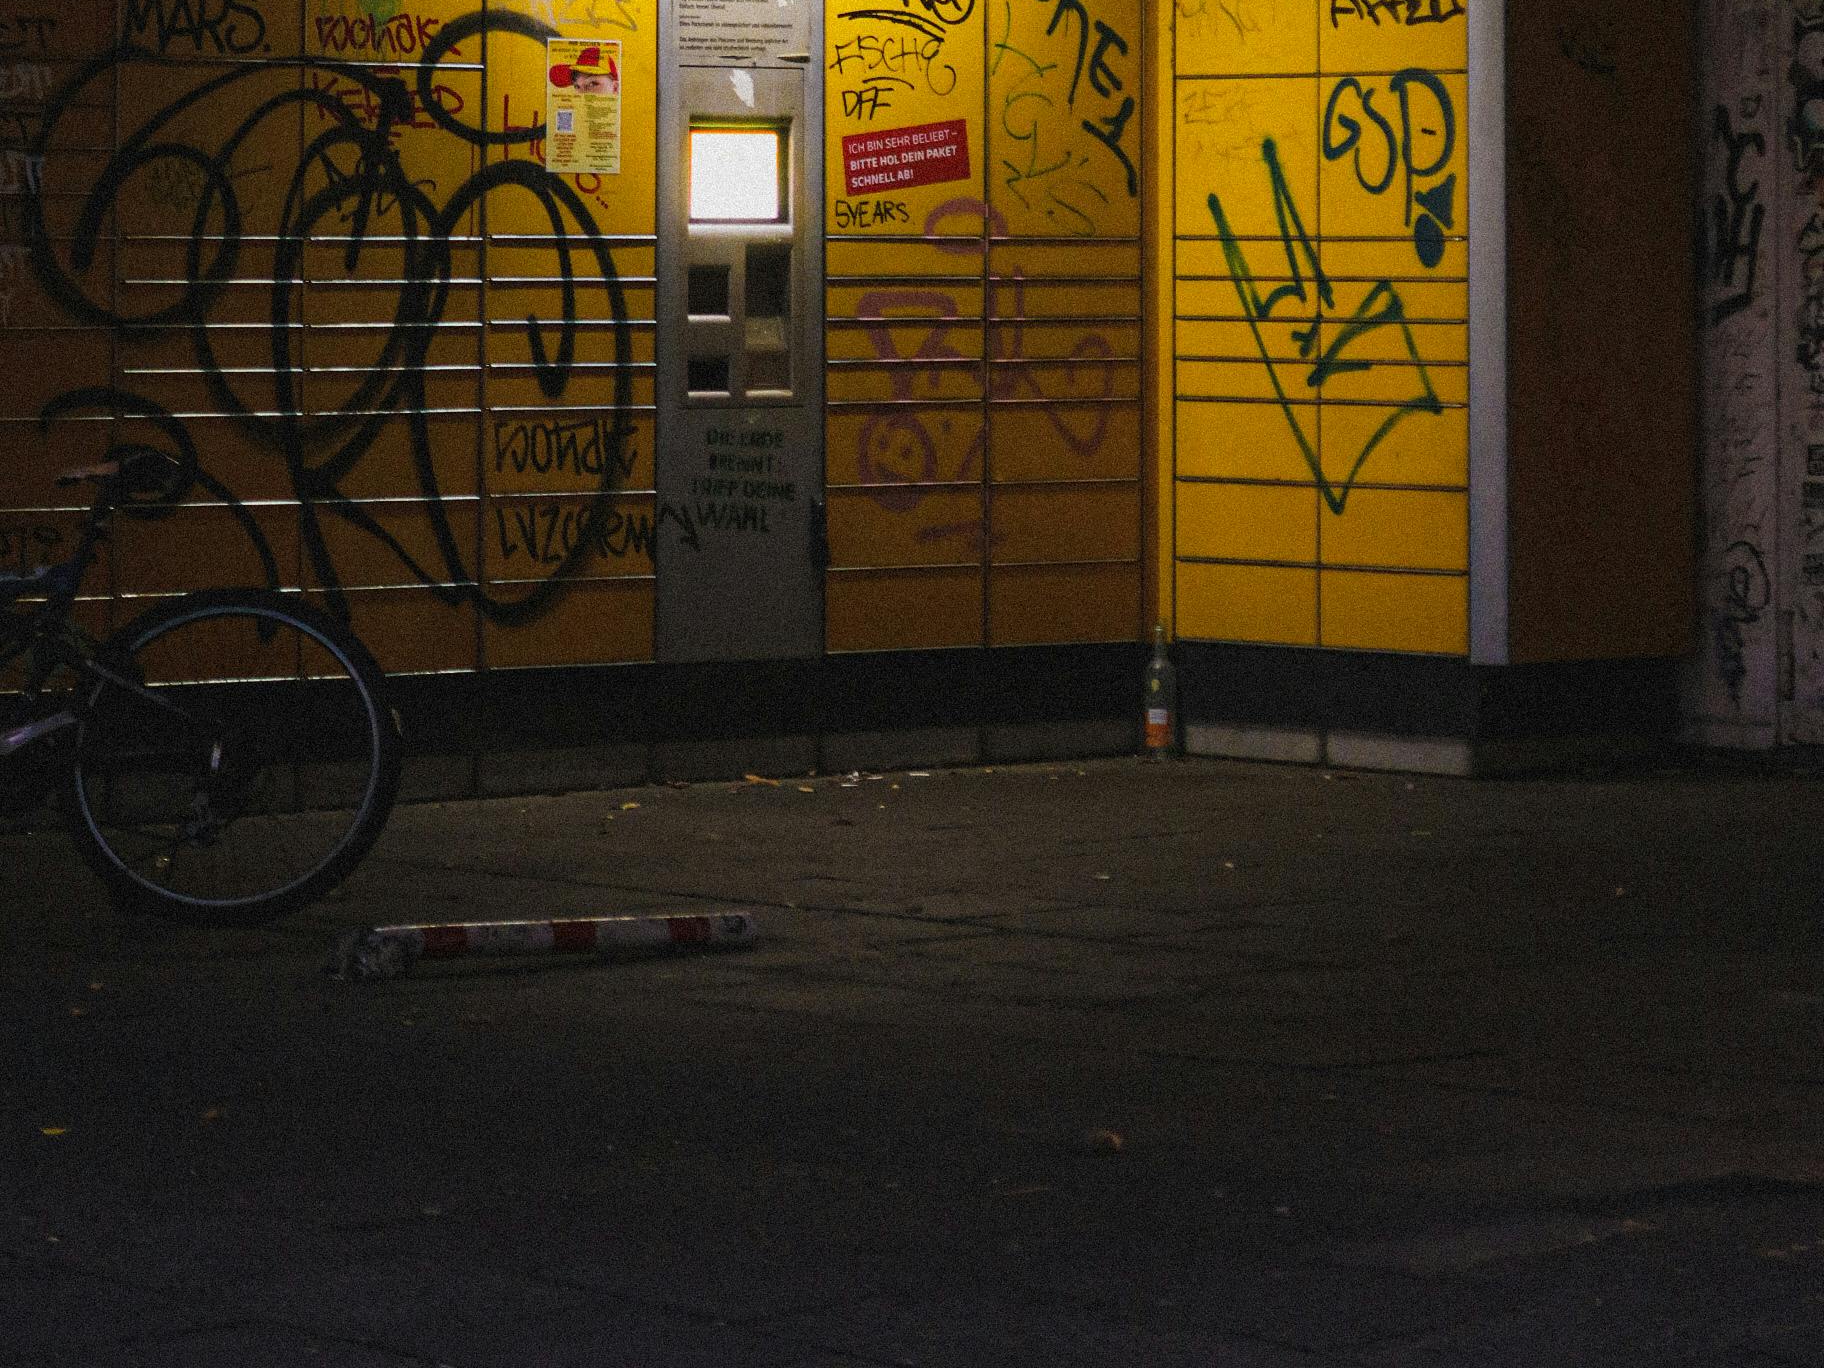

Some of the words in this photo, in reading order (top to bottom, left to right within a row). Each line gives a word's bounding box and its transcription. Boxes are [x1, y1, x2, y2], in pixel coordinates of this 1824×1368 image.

[848, 143, 865, 155] ICH
[867, 140, 884, 152] BIN
[885, 135, 911, 149] SEHR
[912, 129, 950, 146] BELIEBT
[850, 157, 879, 172] BITTE
[880, 154, 900, 166] HOL
[902, 150, 925, 163] DEIN
[926, 145, 958, 159] PAKET
[851, 172, 896, 189] SCHNELL
[897, 168, 914, 181] AB!
